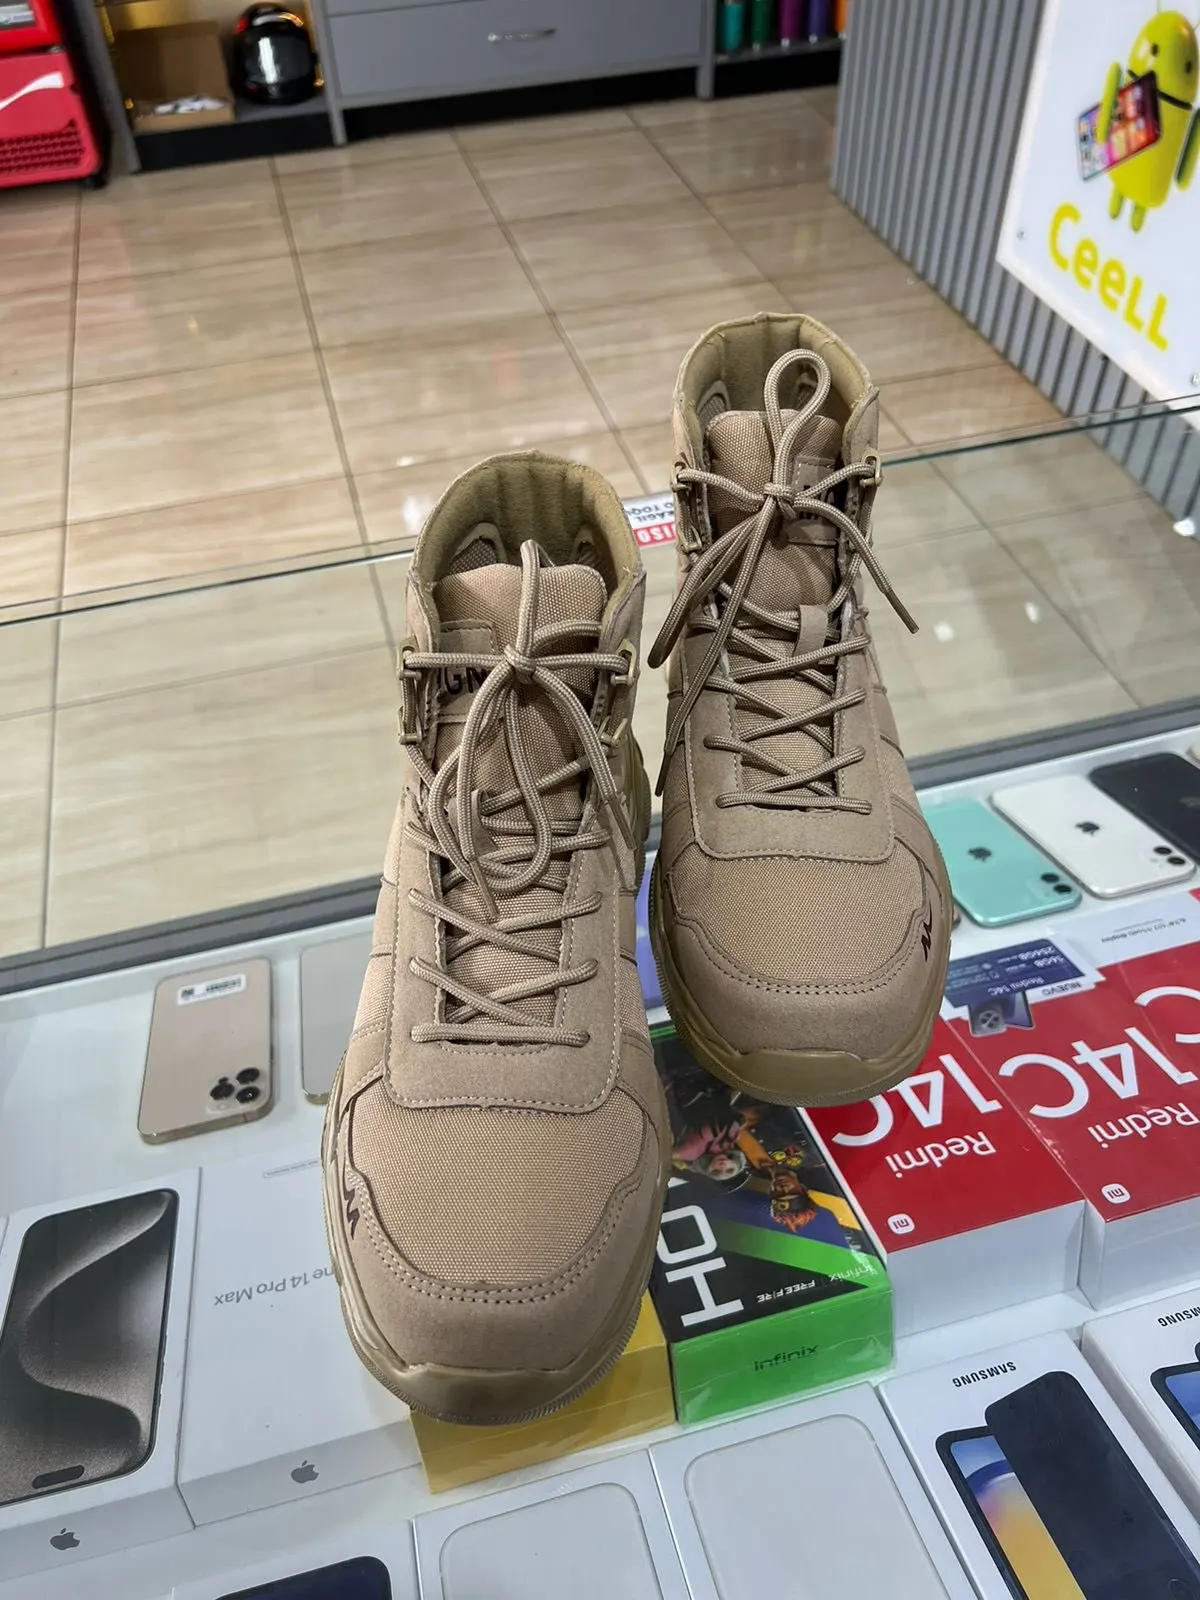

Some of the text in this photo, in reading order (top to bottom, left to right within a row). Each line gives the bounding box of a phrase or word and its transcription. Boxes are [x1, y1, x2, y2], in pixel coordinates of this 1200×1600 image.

[1042, 982, 1082, 996] NUEVO
[999, 1026, 1199, 1118] 14C
[1087, 1102, 1200, 1149] Redmi
[885, 1131, 996, 1178] Redmi
[656, 1190, 744, 1327] HO
[256, 1278, 287, 1294] Pro
[290, 1272, 310, 1289] 14
[214, 1286, 253, 1306] Max
[952, 1361, 1017, 1388] SAMSUNG
